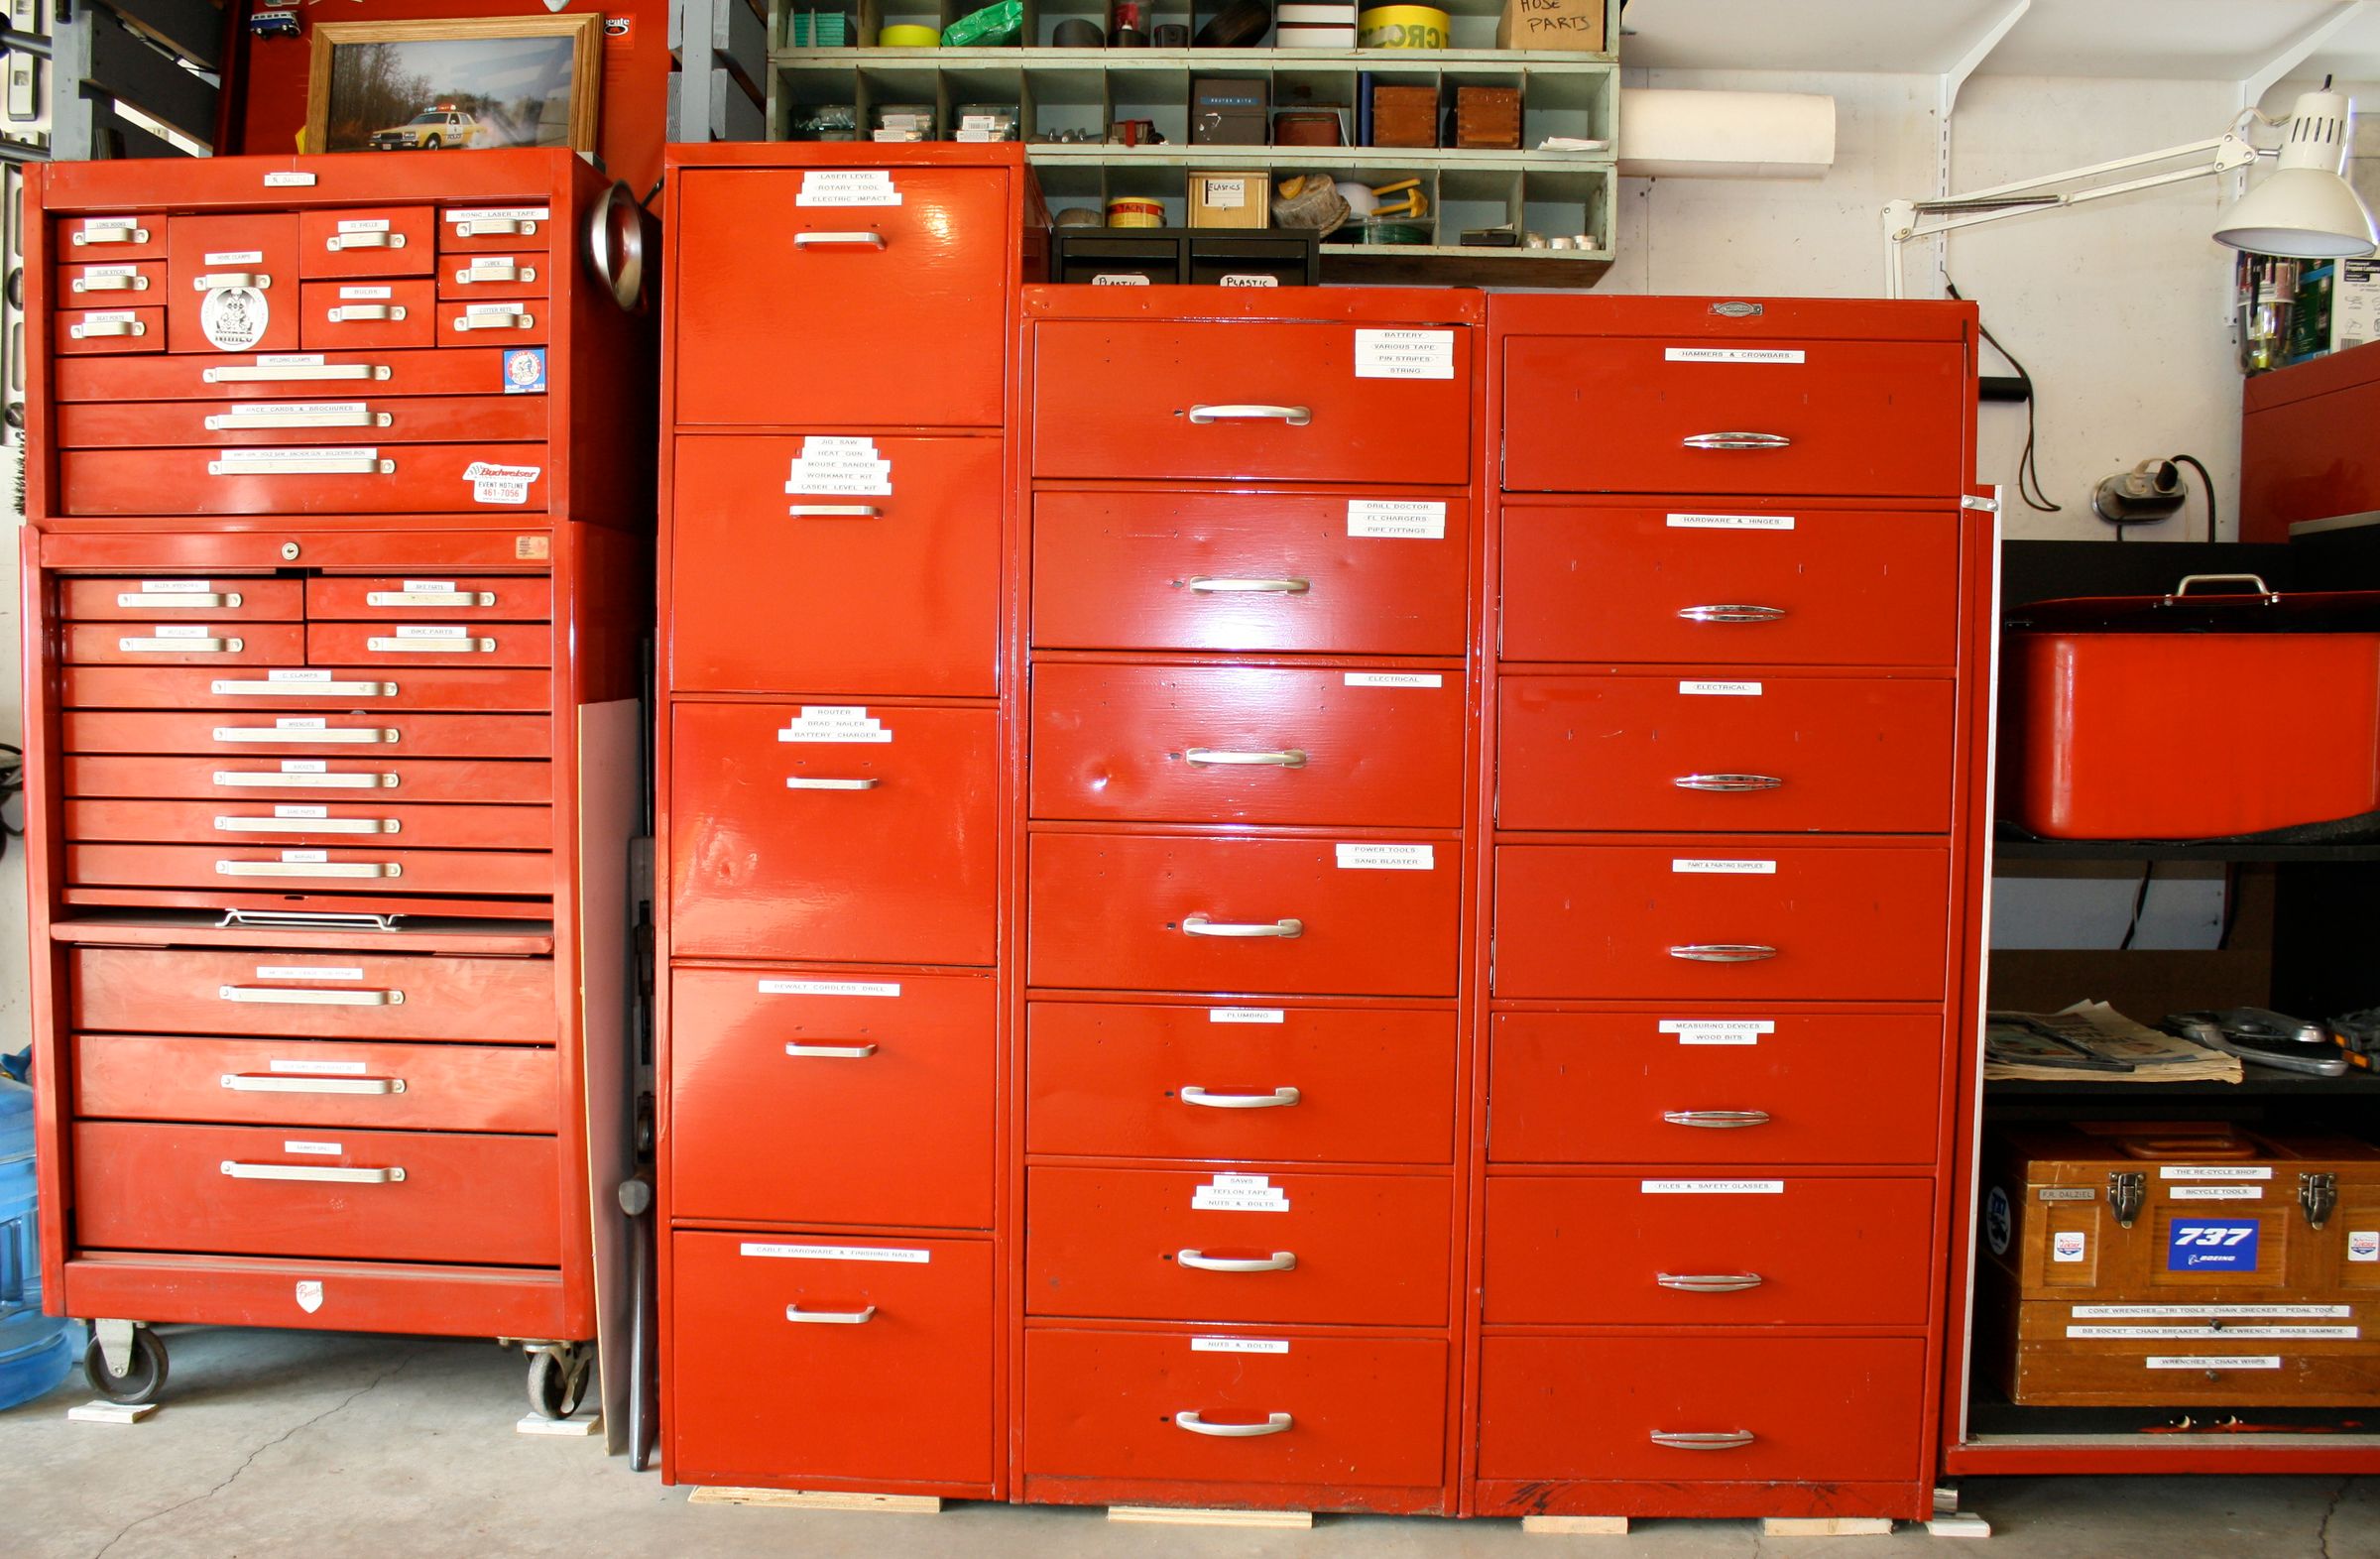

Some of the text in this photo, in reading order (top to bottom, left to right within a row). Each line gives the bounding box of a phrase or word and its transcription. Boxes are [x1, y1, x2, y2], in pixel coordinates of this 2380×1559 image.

[1520, 0, 1561, 13] HOSE
[1527, 16, 1591, 33] PARTS
[1208, 182, 1241, 191] ELASTICS
[1227, 277, 1268, 287] PLASTIC
[479, 468, 536, 477] Budweiser
[2175, 1228, 2253, 1245] 737
